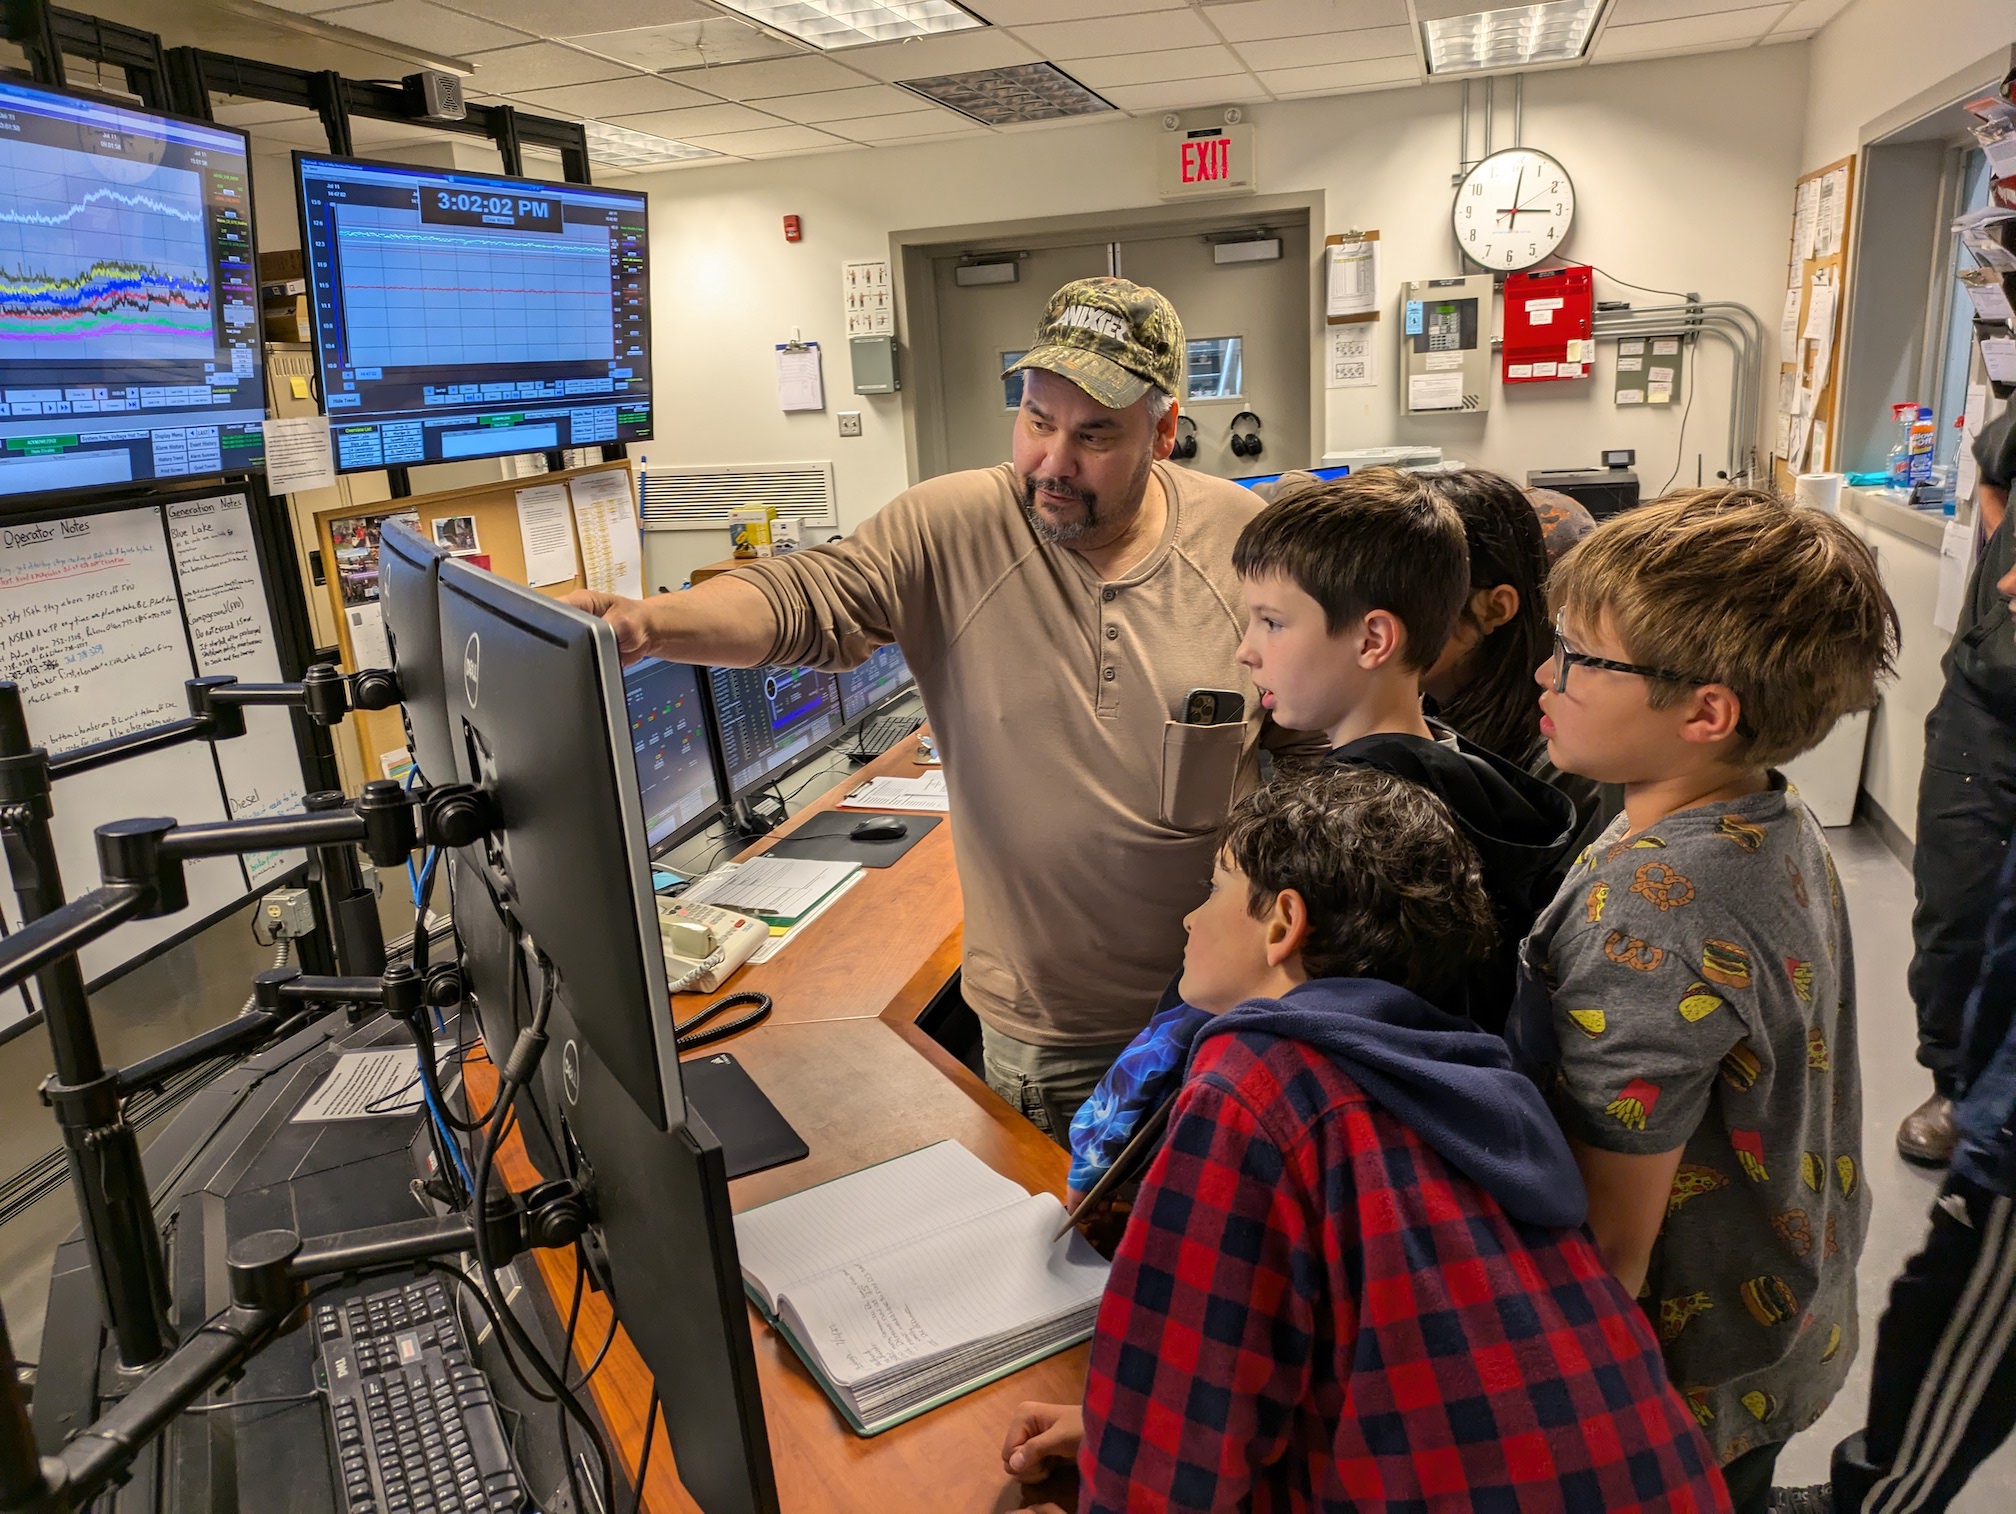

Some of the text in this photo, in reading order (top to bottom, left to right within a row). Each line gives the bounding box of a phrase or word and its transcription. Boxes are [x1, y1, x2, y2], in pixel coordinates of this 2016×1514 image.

[1182, 139, 1231, 182] EXIT
[1538, 165, 1542, 177] 1
[1472, 184, 1482, 196] 10
[1551, 181, 1558, 194] 2
[438, 192, 549, 218] 3:02:02 PM
[1556, 203, 1562, 216] 3
[1466, 206, 1472, 218] 9
[1470, 229, 1476, 242] 8
[1547, 226, 1554, 240] 4
[1485, 245, 1492, 257] 7
[1506, 250, 1513, 262] 6
[1529, 244, 1536, 256] 5
[1054, 306, 1129, 342] ANIXTER
[202, 440, 218, 448] History
[168, 498, 242, 518] Generation Notes
[4, 519, 90, 548] Operator Notes
[171, 522, 214, 540] Blue Lake
[23, 608, 41, 618] 15th
[61, 596, 83, 606] above
[196, 628, 204, 640] Do
[230, 788, 260, 814] Diesel
